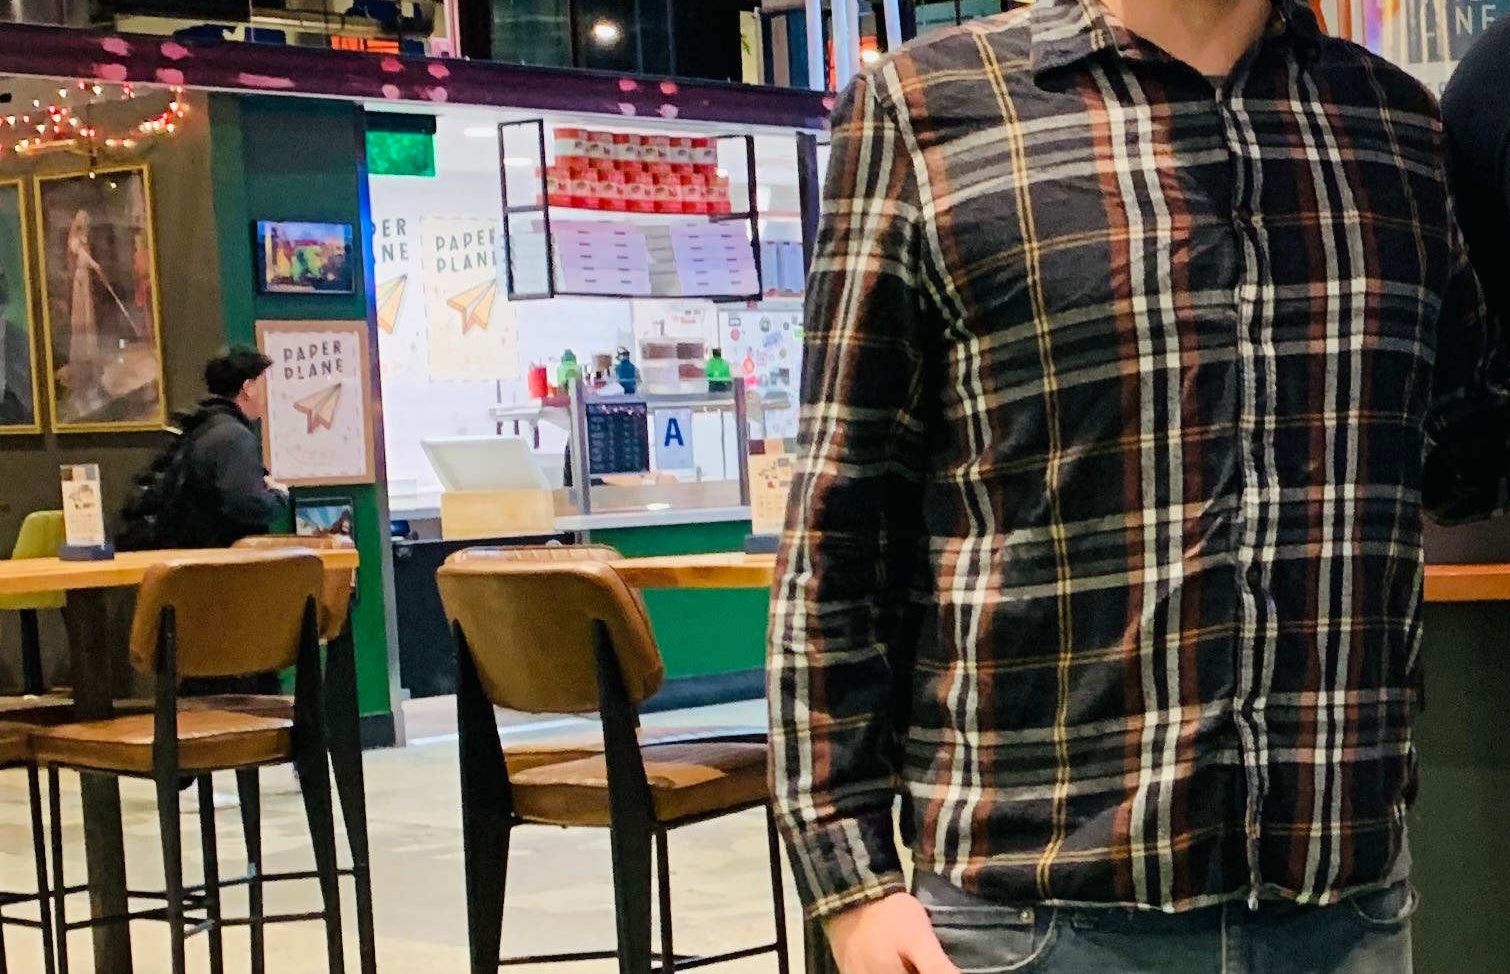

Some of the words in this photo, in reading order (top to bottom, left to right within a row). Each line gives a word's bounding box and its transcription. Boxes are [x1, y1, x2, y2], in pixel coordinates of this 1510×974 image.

[283, 339, 343, 363] PAPER
[284, 358, 345, 381] PLANE
[664, 417, 685, 447] A
